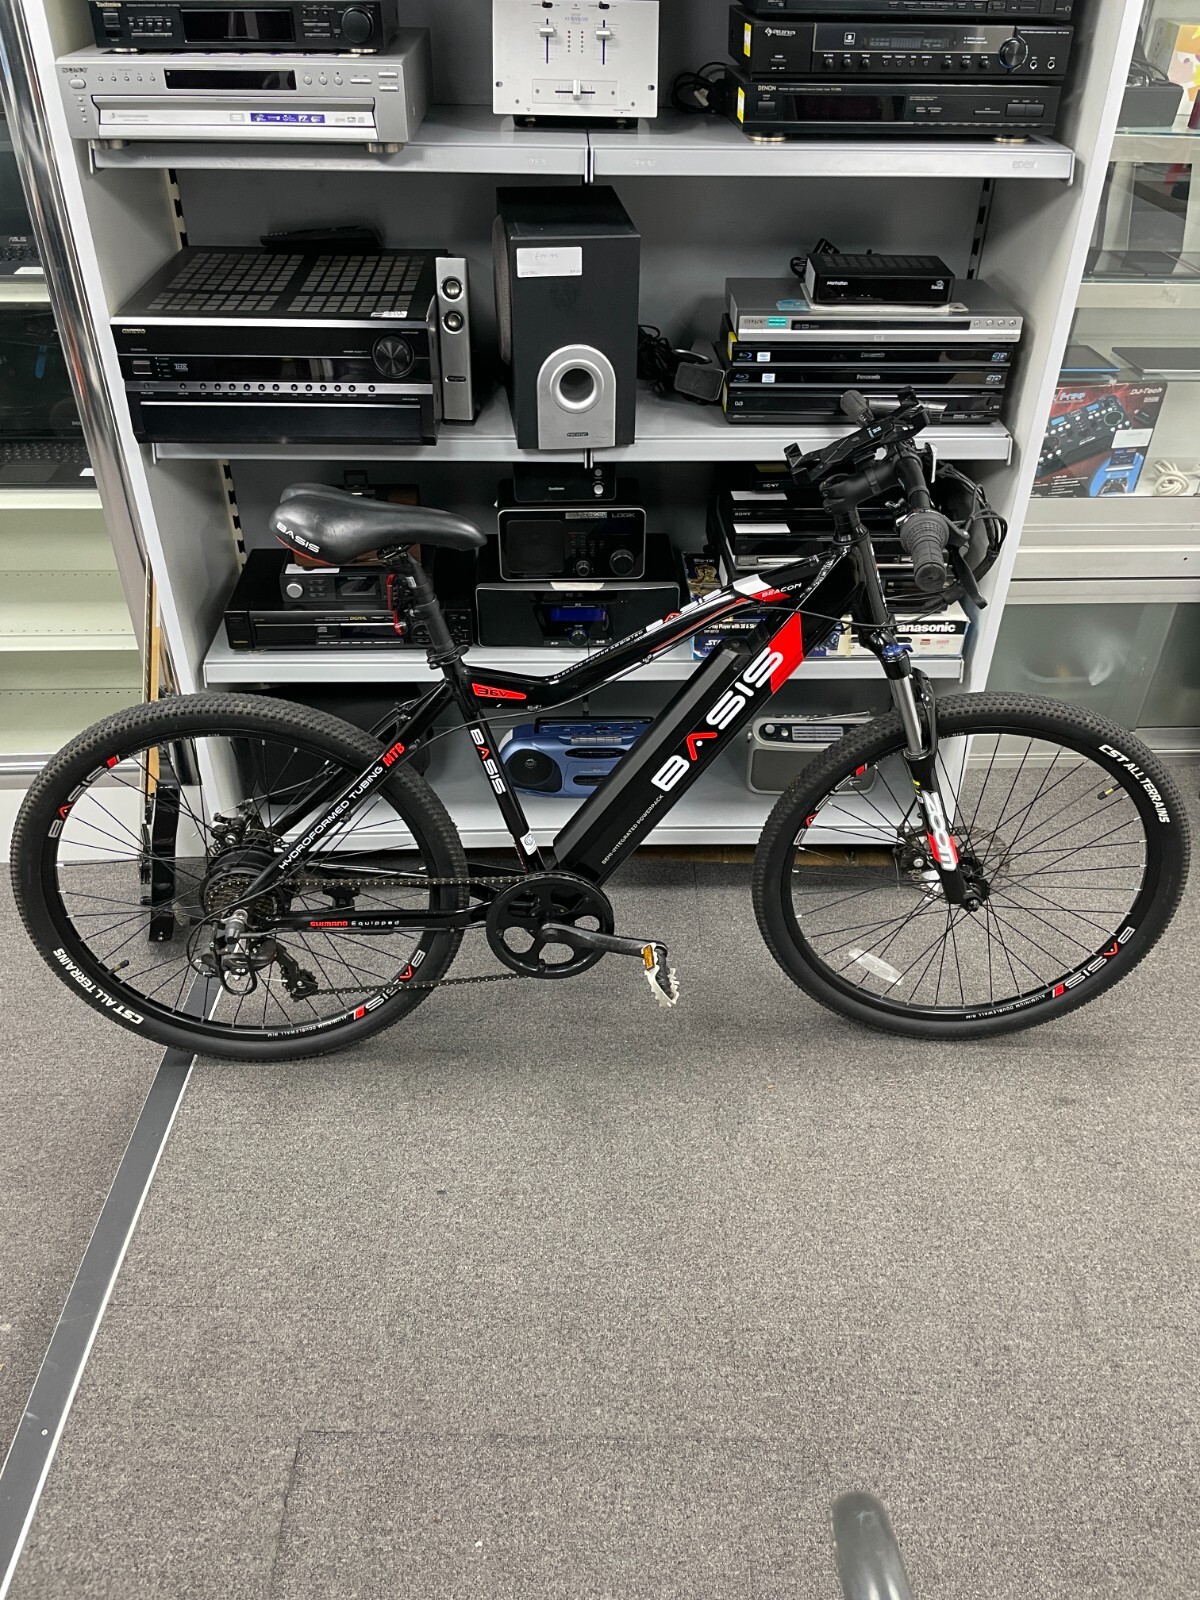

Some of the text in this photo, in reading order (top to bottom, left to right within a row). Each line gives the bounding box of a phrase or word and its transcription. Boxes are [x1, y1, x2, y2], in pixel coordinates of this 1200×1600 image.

[276, 521, 321, 553] BASIS
[761, 582, 802, 598] BEACON
[897, 622, 956, 632] anasonic
[477, 687, 508, 697] 36V
[651, 647, 784, 792] BASIS
[469, 728, 507, 795] BASIS
[1098, 743, 1171, 824] CST ALL TERRAINS
[47, 765, 109, 838] BASIS
[278, 742, 406, 870] HYDROFORMED TUBING MTB
[601, 794, 665, 866] SEMI-INTEGRATED POWERPACK
[52, 947, 145, 1025] CST ALL TERRAINS
[1064, 926, 1136, 989] BASIS
[978, 1005, 1014, 1018] DOUBLEWALL
[1015, 993, 1046, 1008] ALUMINIUM
